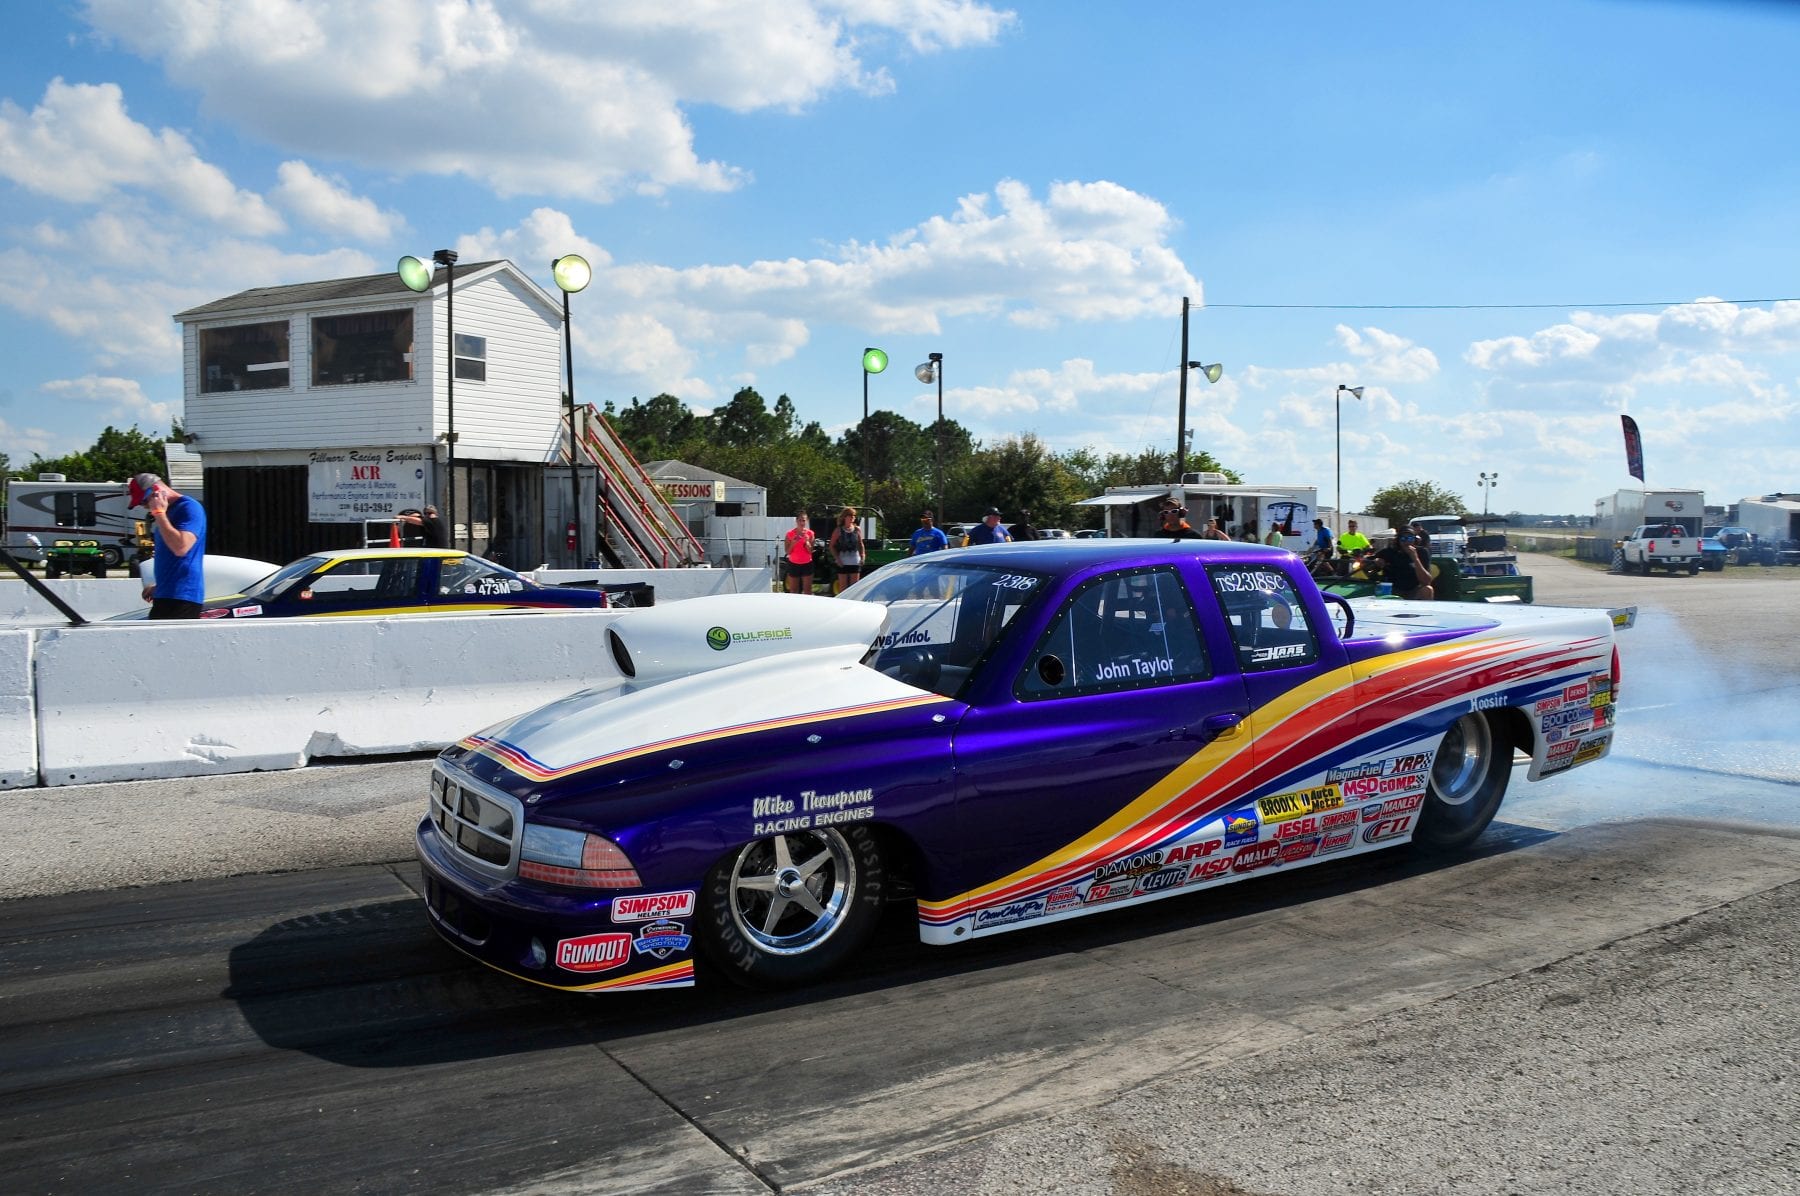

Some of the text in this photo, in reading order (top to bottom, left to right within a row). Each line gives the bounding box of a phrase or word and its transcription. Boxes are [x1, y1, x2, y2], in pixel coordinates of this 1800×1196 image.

[309, 450, 422, 465] Fillmore Racing Engines
[351, 465, 381, 480] ACR
[374, 481, 397, 489] Machine
[312, 491, 346, 500] Performance
[353, 503, 393, 512] 643-3942
[478, 583, 511, 596] 473M
[991, 574, 1038, 590] 2318
[1215, 572, 1285, 592] TS2318SC
[732, 629, 792, 640] GULFSIDE
[1267, 645, 1305, 660] HAAS
[1096, 657, 1175, 680] John Taylor
[1543, 709, 1579, 729] sparco
[1327, 761, 1384, 783] MagnaFuel
[1391, 754, 1425, 773] XRP
[1344, 777, 1378, 797] MSD
[1379, 774, 1416, 794] COMP
[753, 788, 874, 818] Mike Thompson
[1311, 788, 1334, 800] Auto
[1260, 794, 1299, 816] BRODIX
[1312, 797, 1341, 812] Meter
[1382, 796, 1420, 814] MANLEY
[754, 806, 875, 835] RACING ENGINES
[1228, 820, 1256, 832] SUNOCO
[1273, 817, 1319, 838] JESEL
[1322, 810, 1358, 828] SIMPSON
[1164, 840, 1222, 864] ARP
[1234, 846, 1279, 866] AMALIE
[1095, 851, 1163, 879] DIAMOND
[1189, 857, 1233, 878] MSD
[1141, 870, 1187, 889] CLEVITE
[617, 894, 689, 914] SIMPSON
[637, 910, 671, 918] HELMETS
[637, 936, 688, 946] SPORTSMAN
[561, 938, 627, 964] GUMOUT
